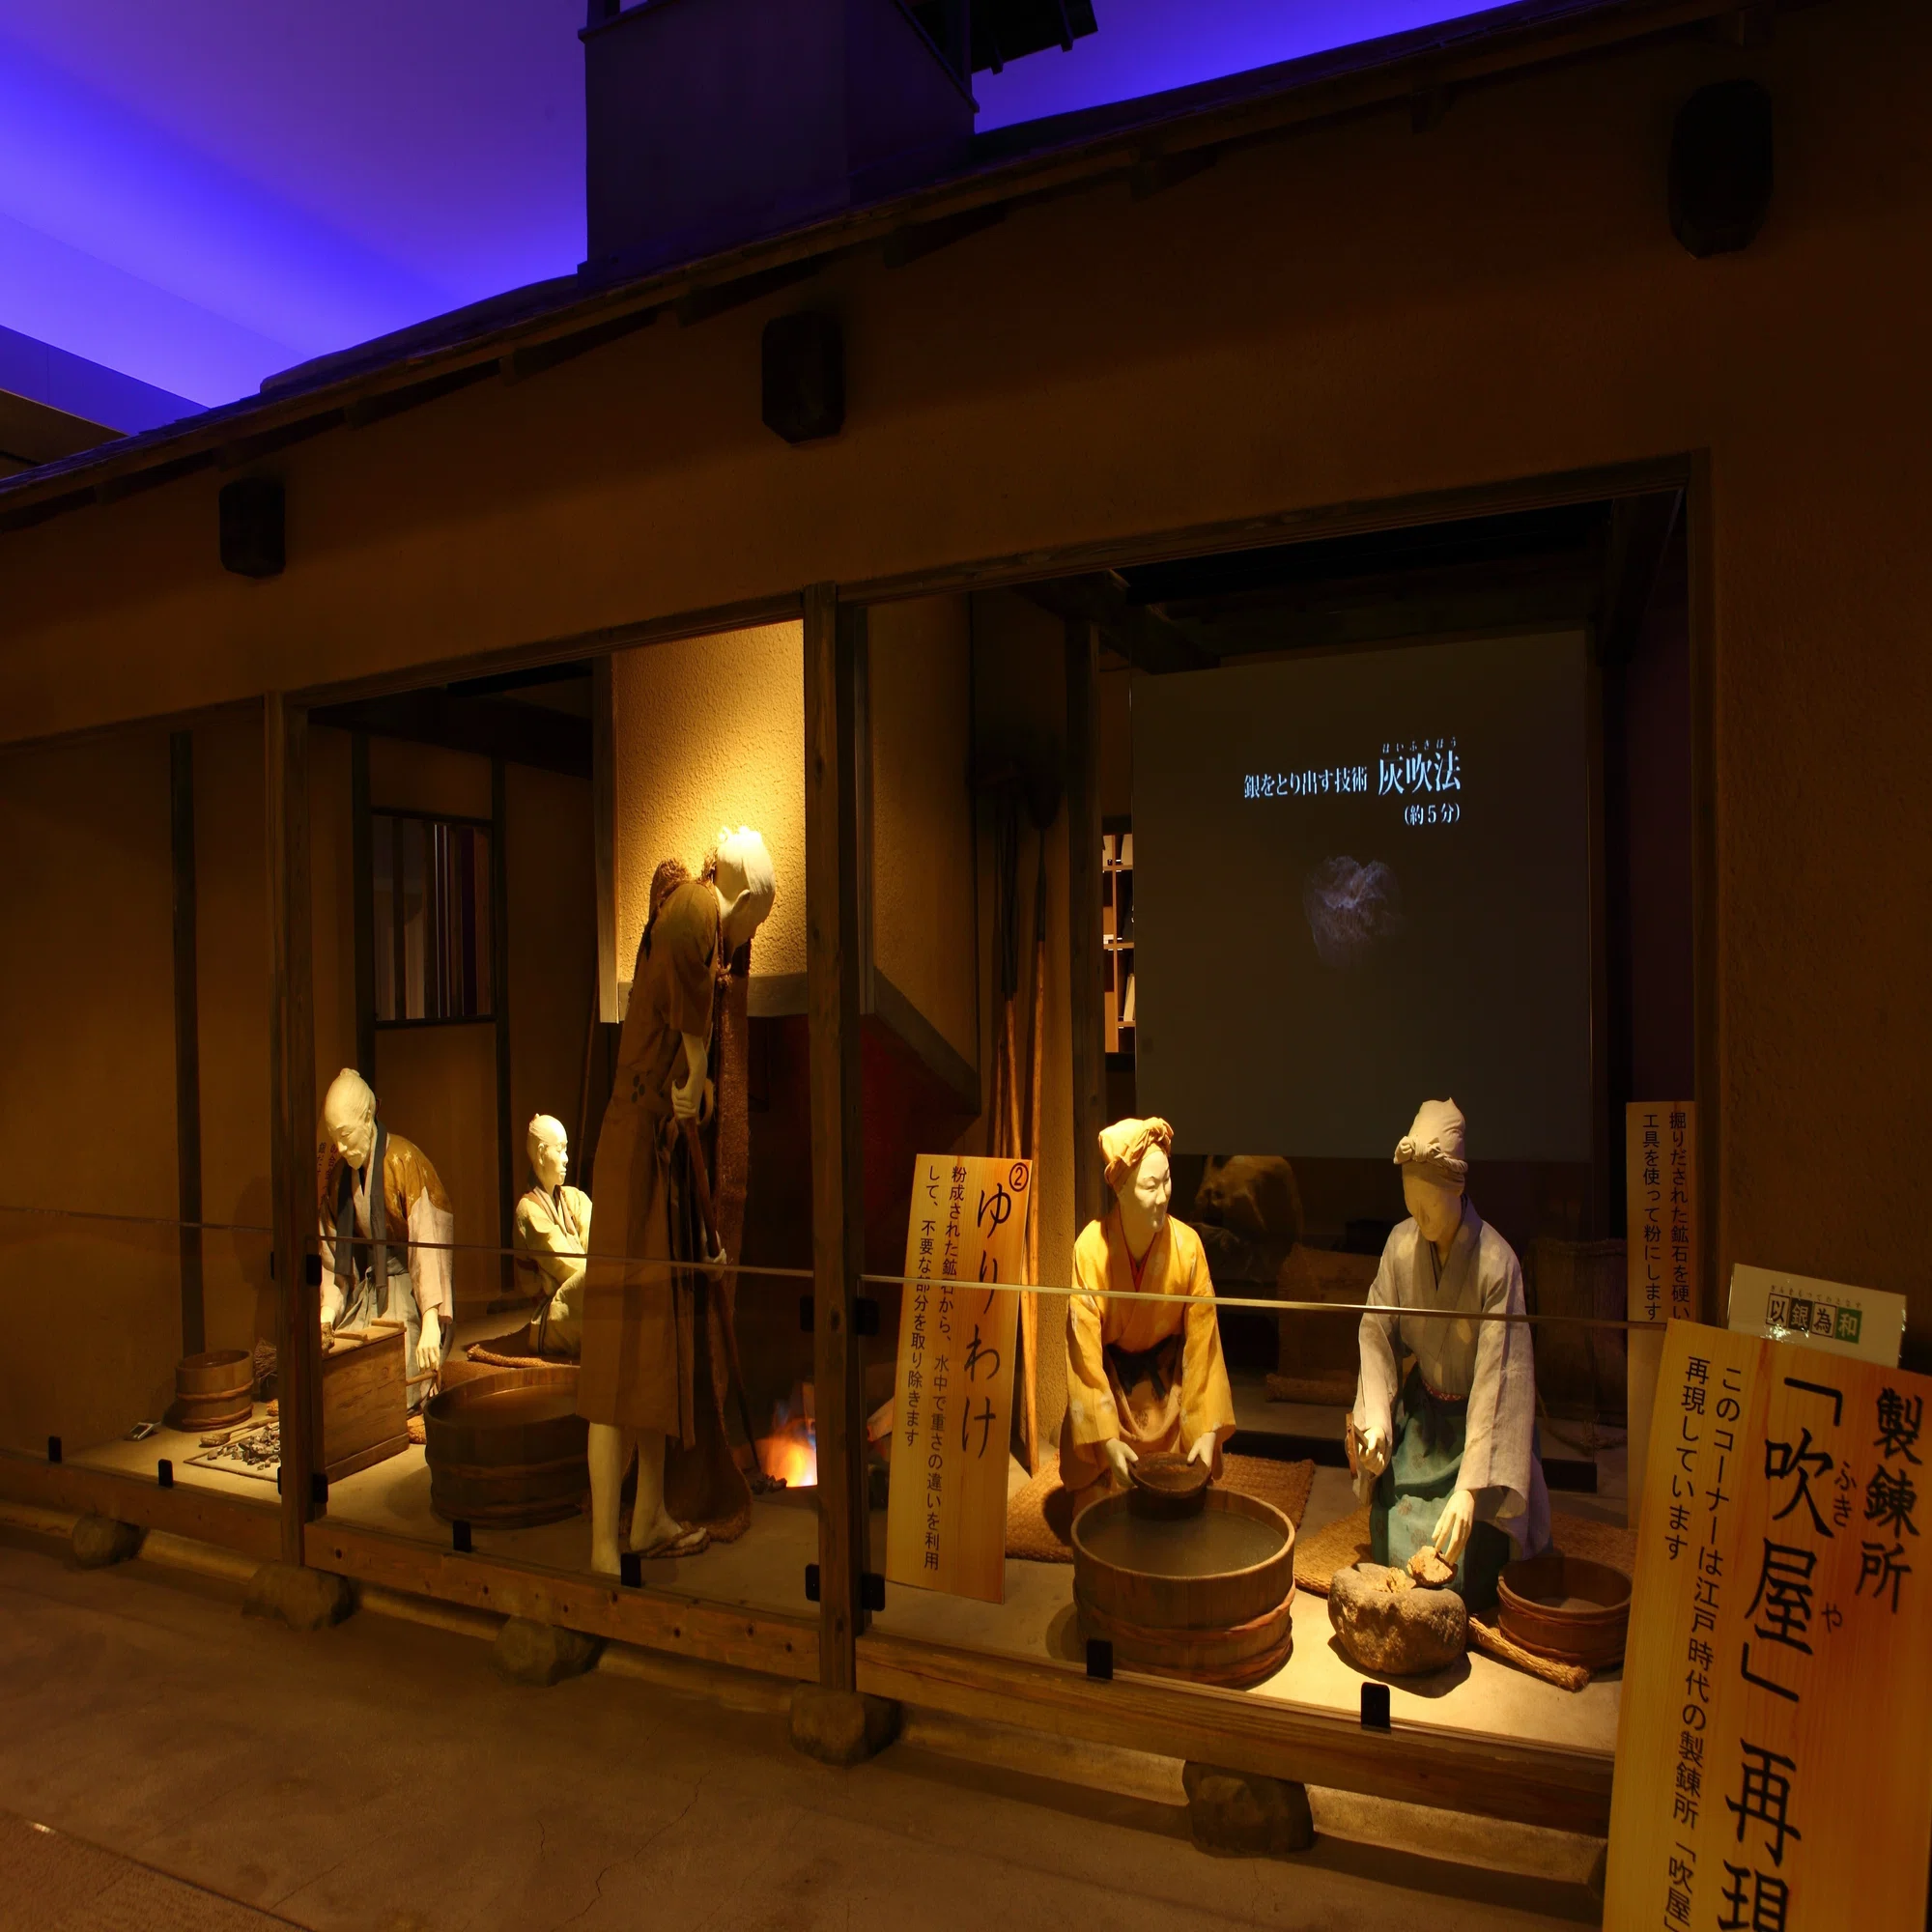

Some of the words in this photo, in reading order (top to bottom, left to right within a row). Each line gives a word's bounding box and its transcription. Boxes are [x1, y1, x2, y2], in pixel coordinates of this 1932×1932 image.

[1244, 766, 1368, 799] 銀をとり出す技術
[1378, 751, 1461, 795] 灰吹法
[1642, 1114, 1662, 1321] 工具を使って粉にします
[961, 1182, 1012, 1460] ゆりわけ
[1664, 1355, 1711, 1560] 再現しています
